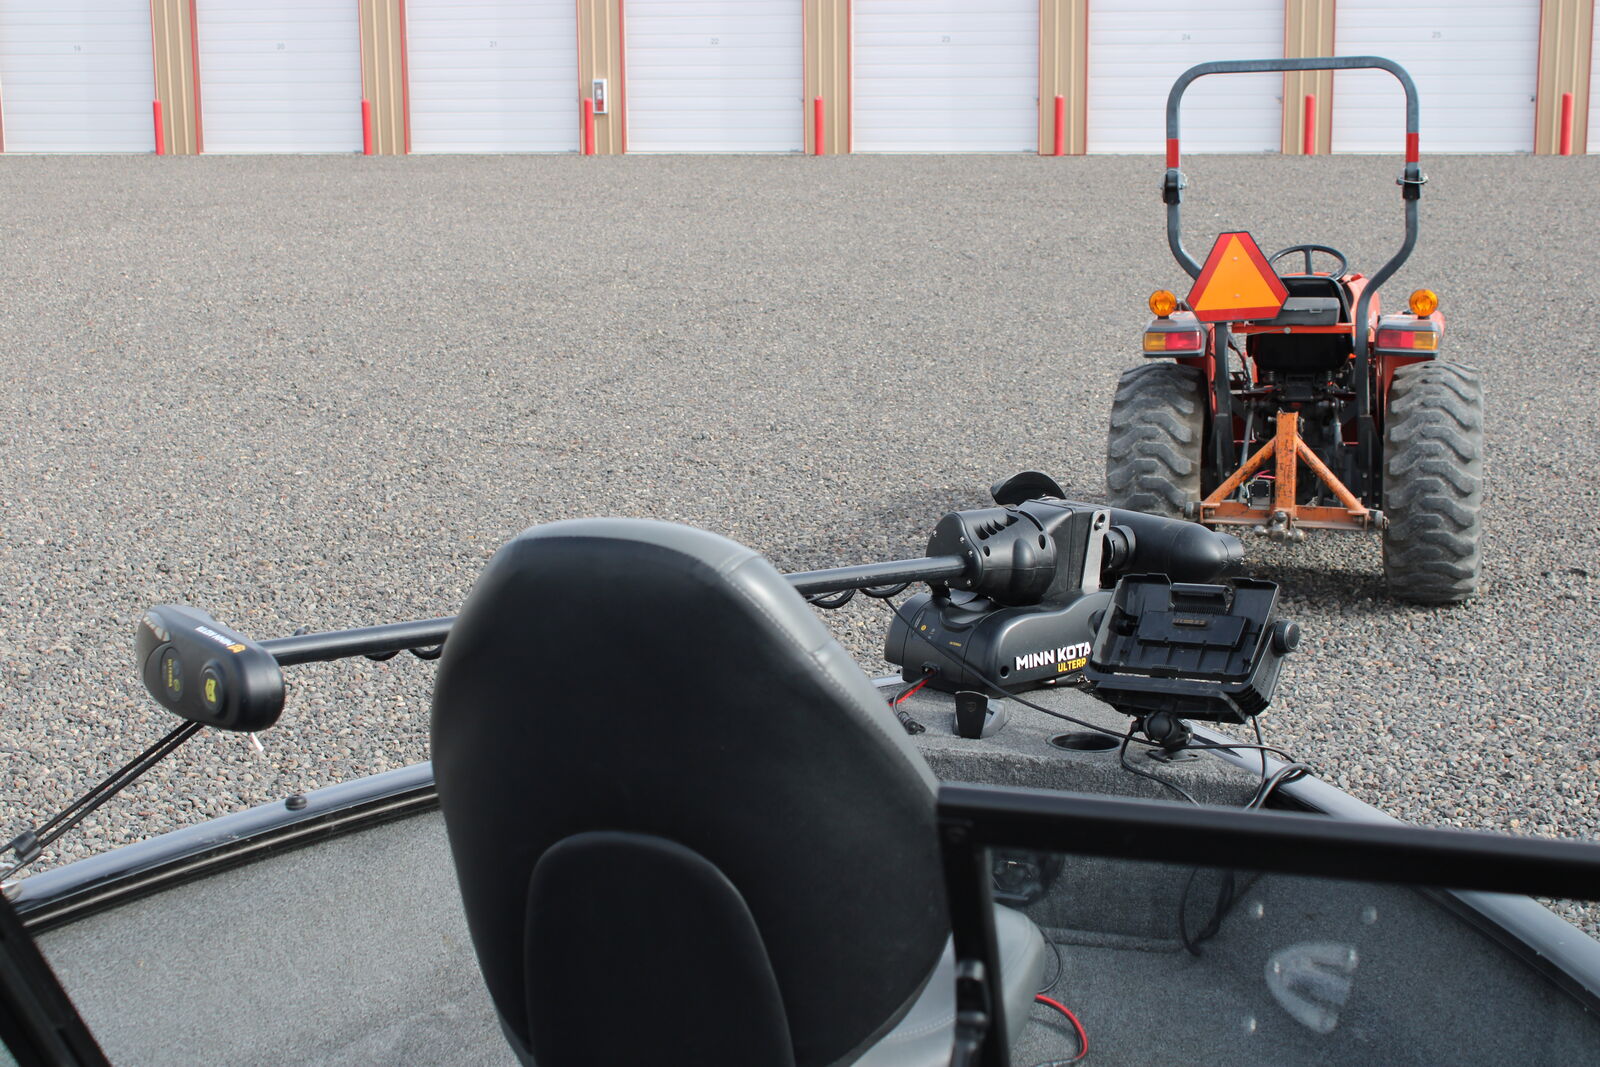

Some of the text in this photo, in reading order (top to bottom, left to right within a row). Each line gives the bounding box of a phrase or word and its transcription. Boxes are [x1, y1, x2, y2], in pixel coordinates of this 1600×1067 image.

[1015, 641, 1092, 671] MINN KOTA
[1057, 657, 1088, 673] ULTERR
